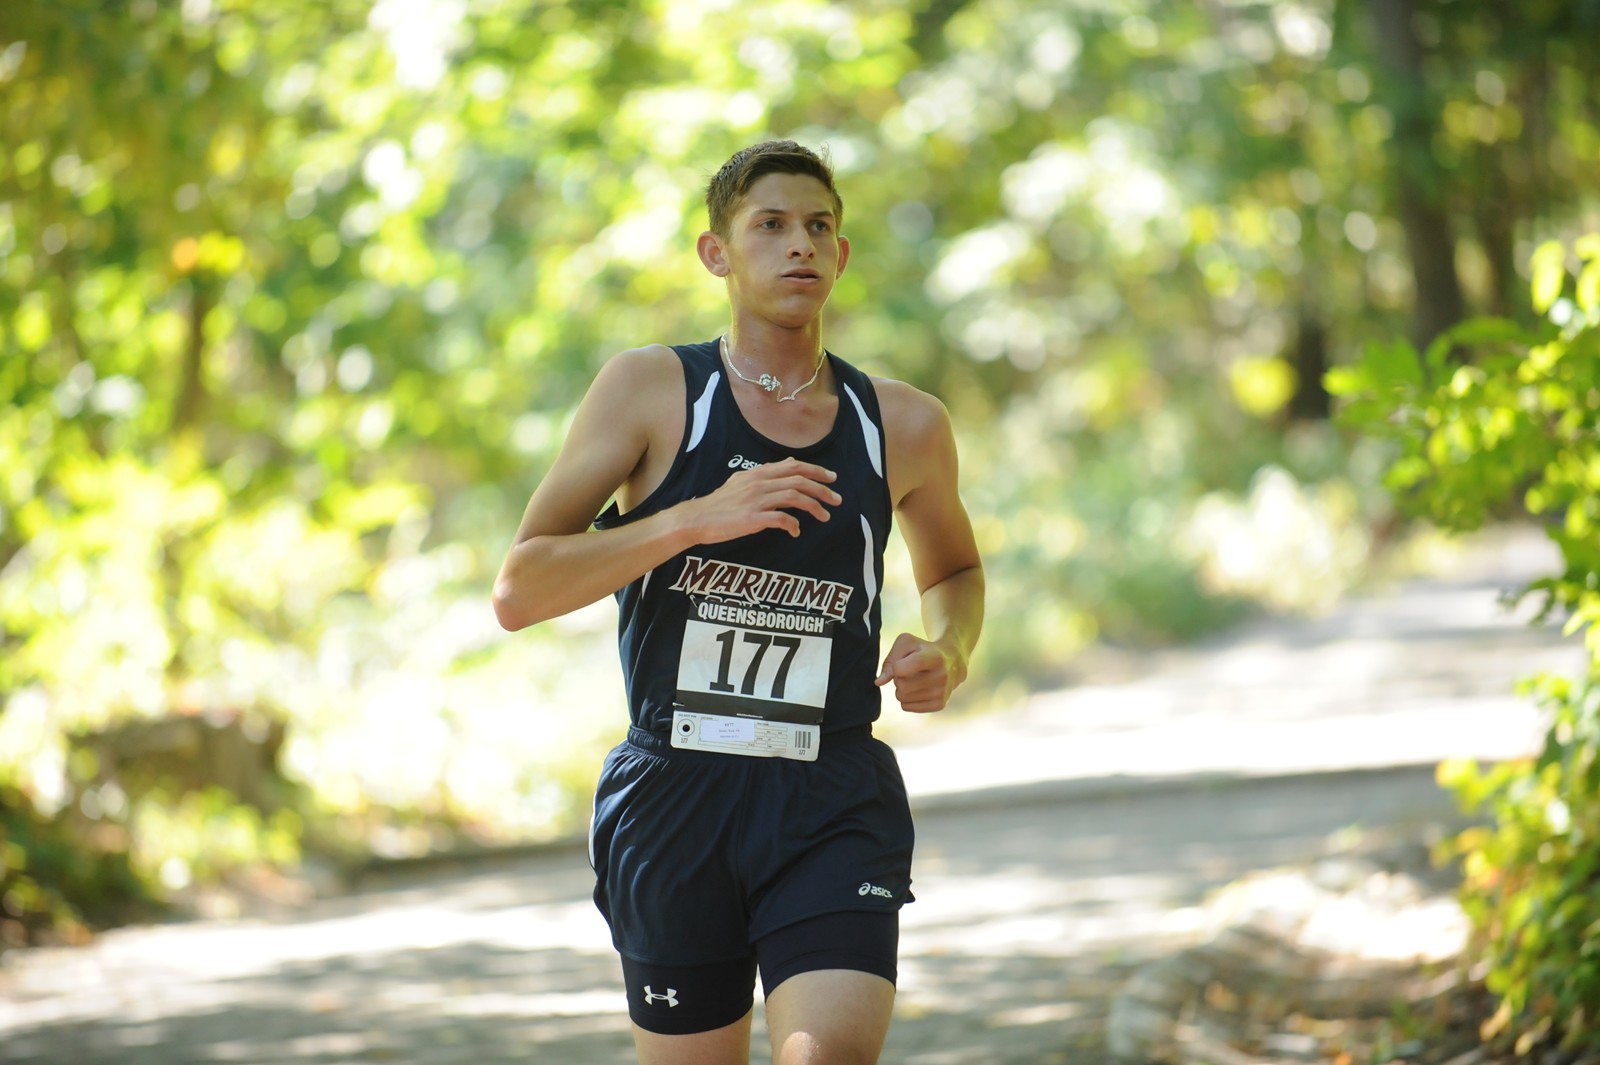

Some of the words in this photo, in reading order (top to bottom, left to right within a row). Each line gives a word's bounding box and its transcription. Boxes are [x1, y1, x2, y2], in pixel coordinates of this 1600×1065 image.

[668, 555, 854, 618] MARITIME
[697, 602, 825, 634] QUEENSBOROUGH
[709, 629, 802, 700] 177
